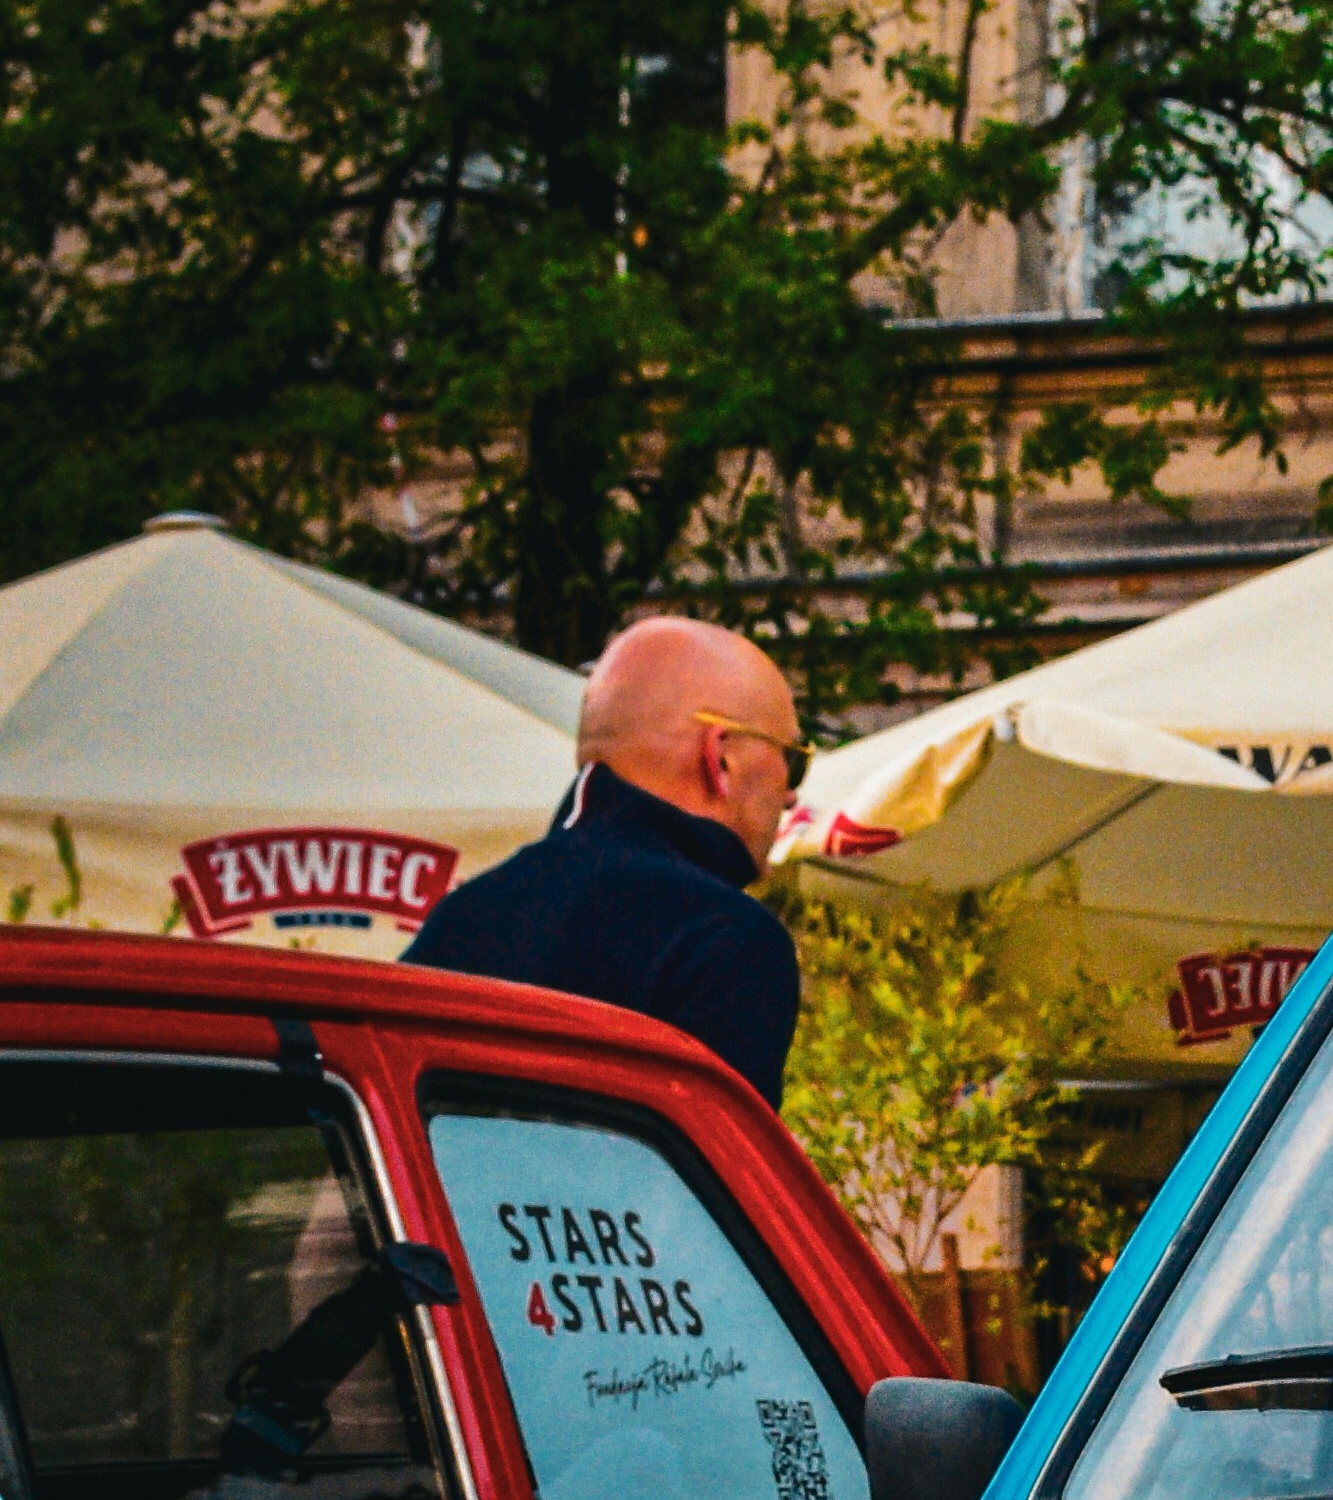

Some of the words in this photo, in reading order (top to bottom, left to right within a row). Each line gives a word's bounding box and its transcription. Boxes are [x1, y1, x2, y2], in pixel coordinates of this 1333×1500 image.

[208, 837, 437, 907] ŻYWIEC
[498, 1202, 654, 1268] STARS
[527, 1273, 704, 1336] 4STARS
